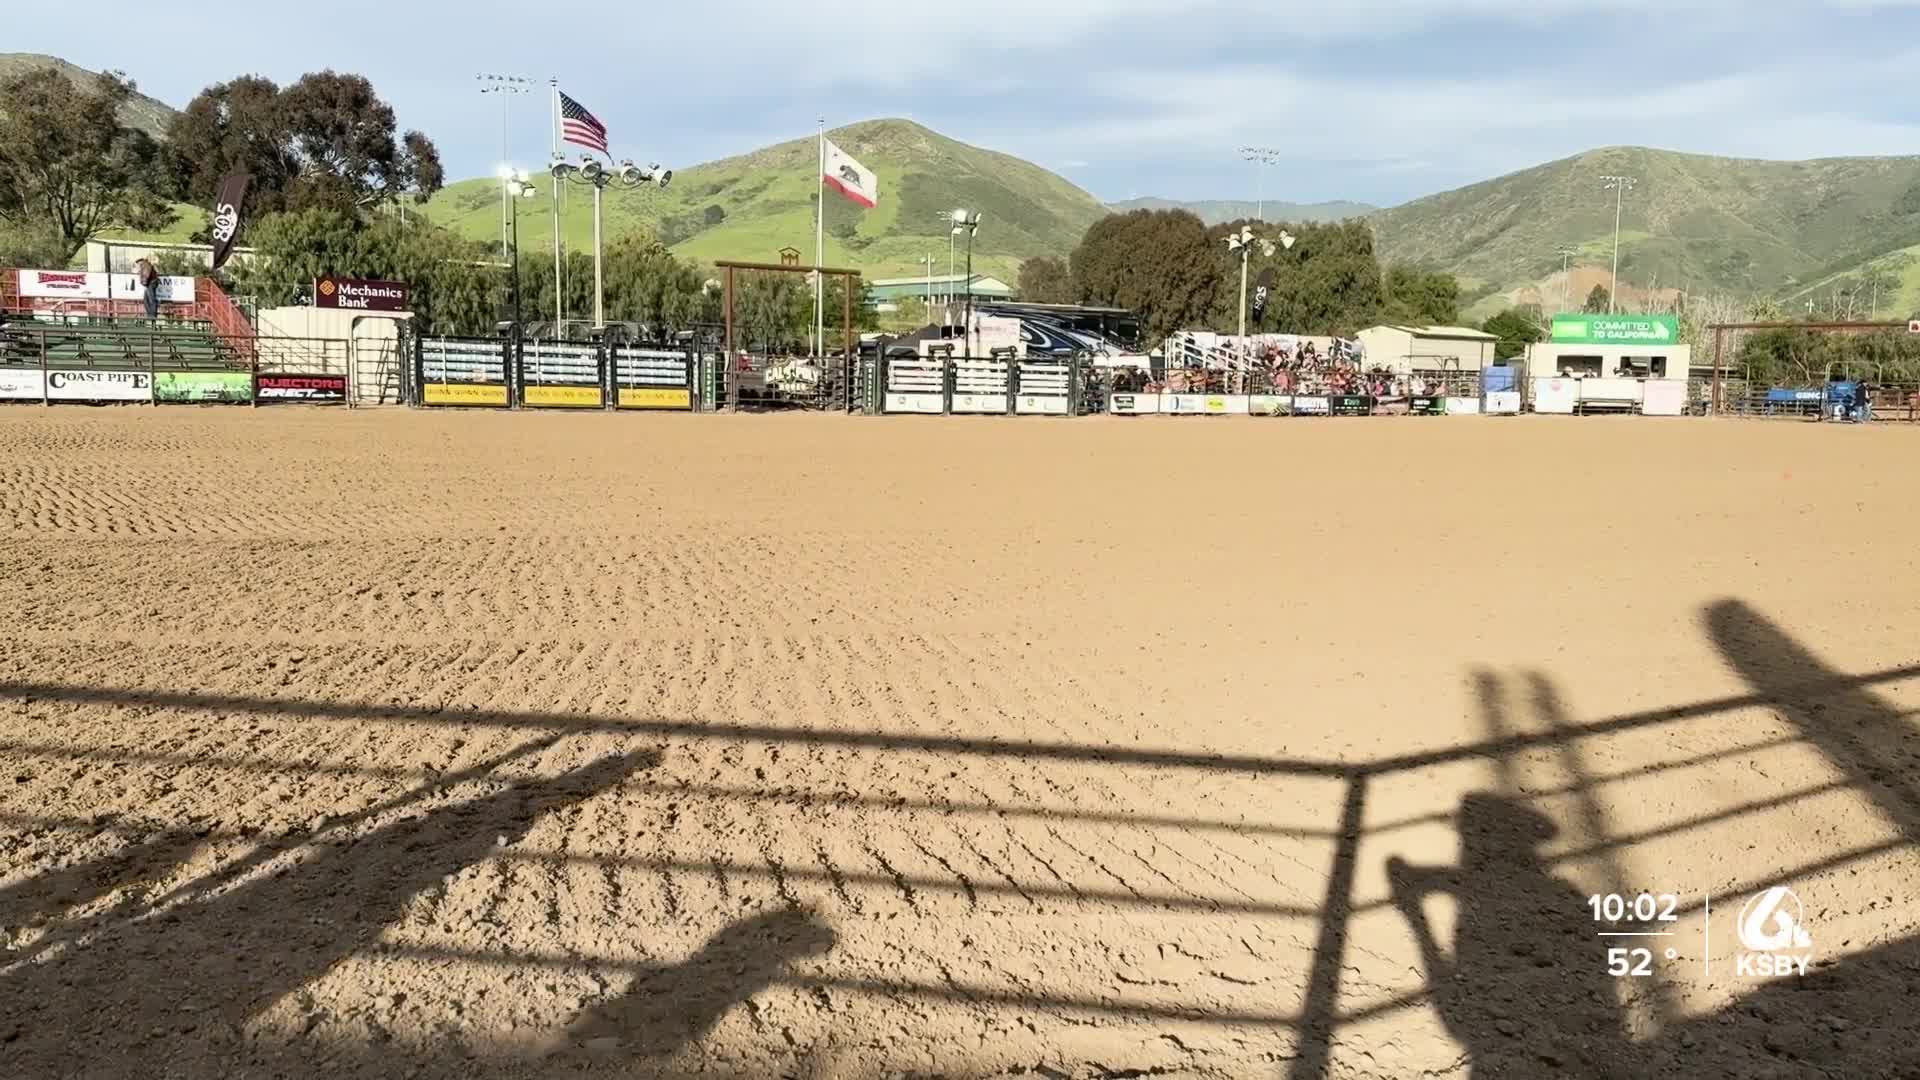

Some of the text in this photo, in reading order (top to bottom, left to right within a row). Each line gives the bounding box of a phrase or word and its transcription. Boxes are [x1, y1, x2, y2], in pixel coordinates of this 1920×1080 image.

[213, 203, 238, 242] 805
[338, 283, 402, 298] Mechanics
[338, 295, 370, 309] Bank
[1593, 320, 1650, 330] COMMITTED
[1592, 330, 1606, 338] TO
[49, 372, 149, 389] COAST PIPE
[258, 378, 343, 388] INJECTORS
[258, 388, 313, 398] DIRECT
